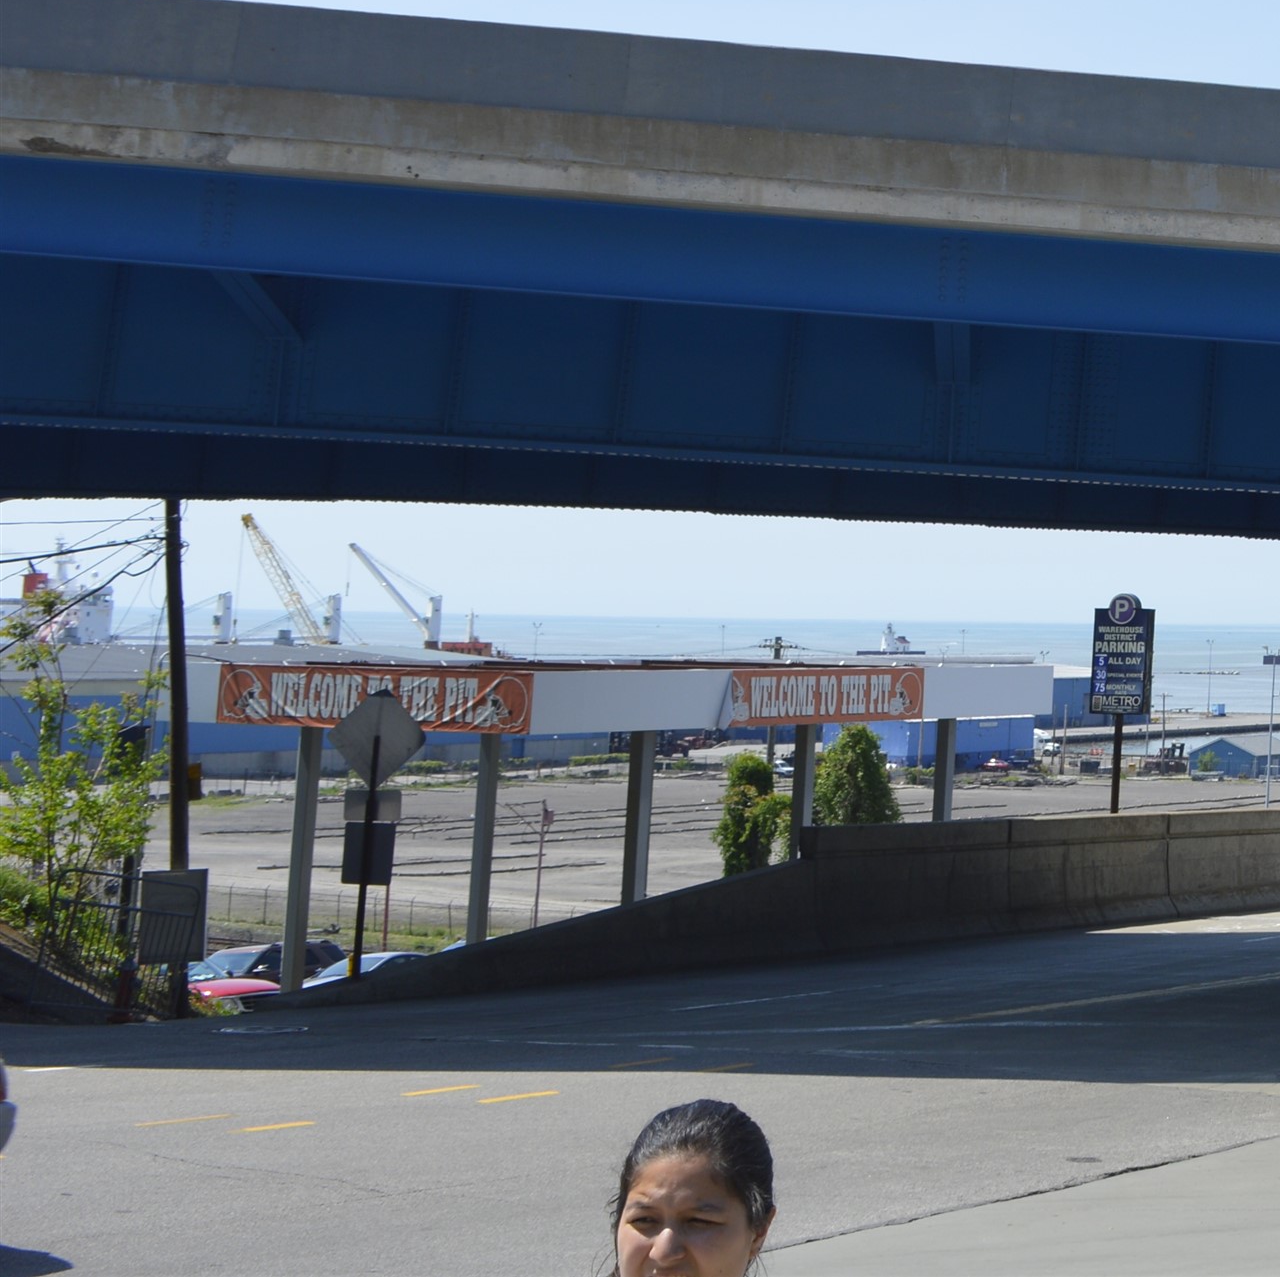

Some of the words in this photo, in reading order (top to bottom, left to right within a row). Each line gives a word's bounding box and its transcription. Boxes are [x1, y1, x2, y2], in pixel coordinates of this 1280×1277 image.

[1114, 599, 1129, 620] P
[1098, 626, 1144, 634] WAREHOUSE
[1103, 633, 1137, 641] DISTRICT
[1094, 641, 1145, 653] PARKING
[1098, 656, 1105, 666] 5
[1108, 656, 1123, 665] ALL
[1125, 656, 1142, 665] DAY
[1095, 670, 1107, 680] 30
[1094, 683, 1106, 693] 75
[271, 672, 362, 719] WELCOME
[399, 676, 440, 722] THE
[442, 677, 480, 723] PIT
[750, 675, 816, 718] WELCOME
[819, 675, 838, 716] TO
[841, 675, 867, 715] THE
[869, 674, 892, 714] PIT
[1102, 695, 1141, 707] METRO
